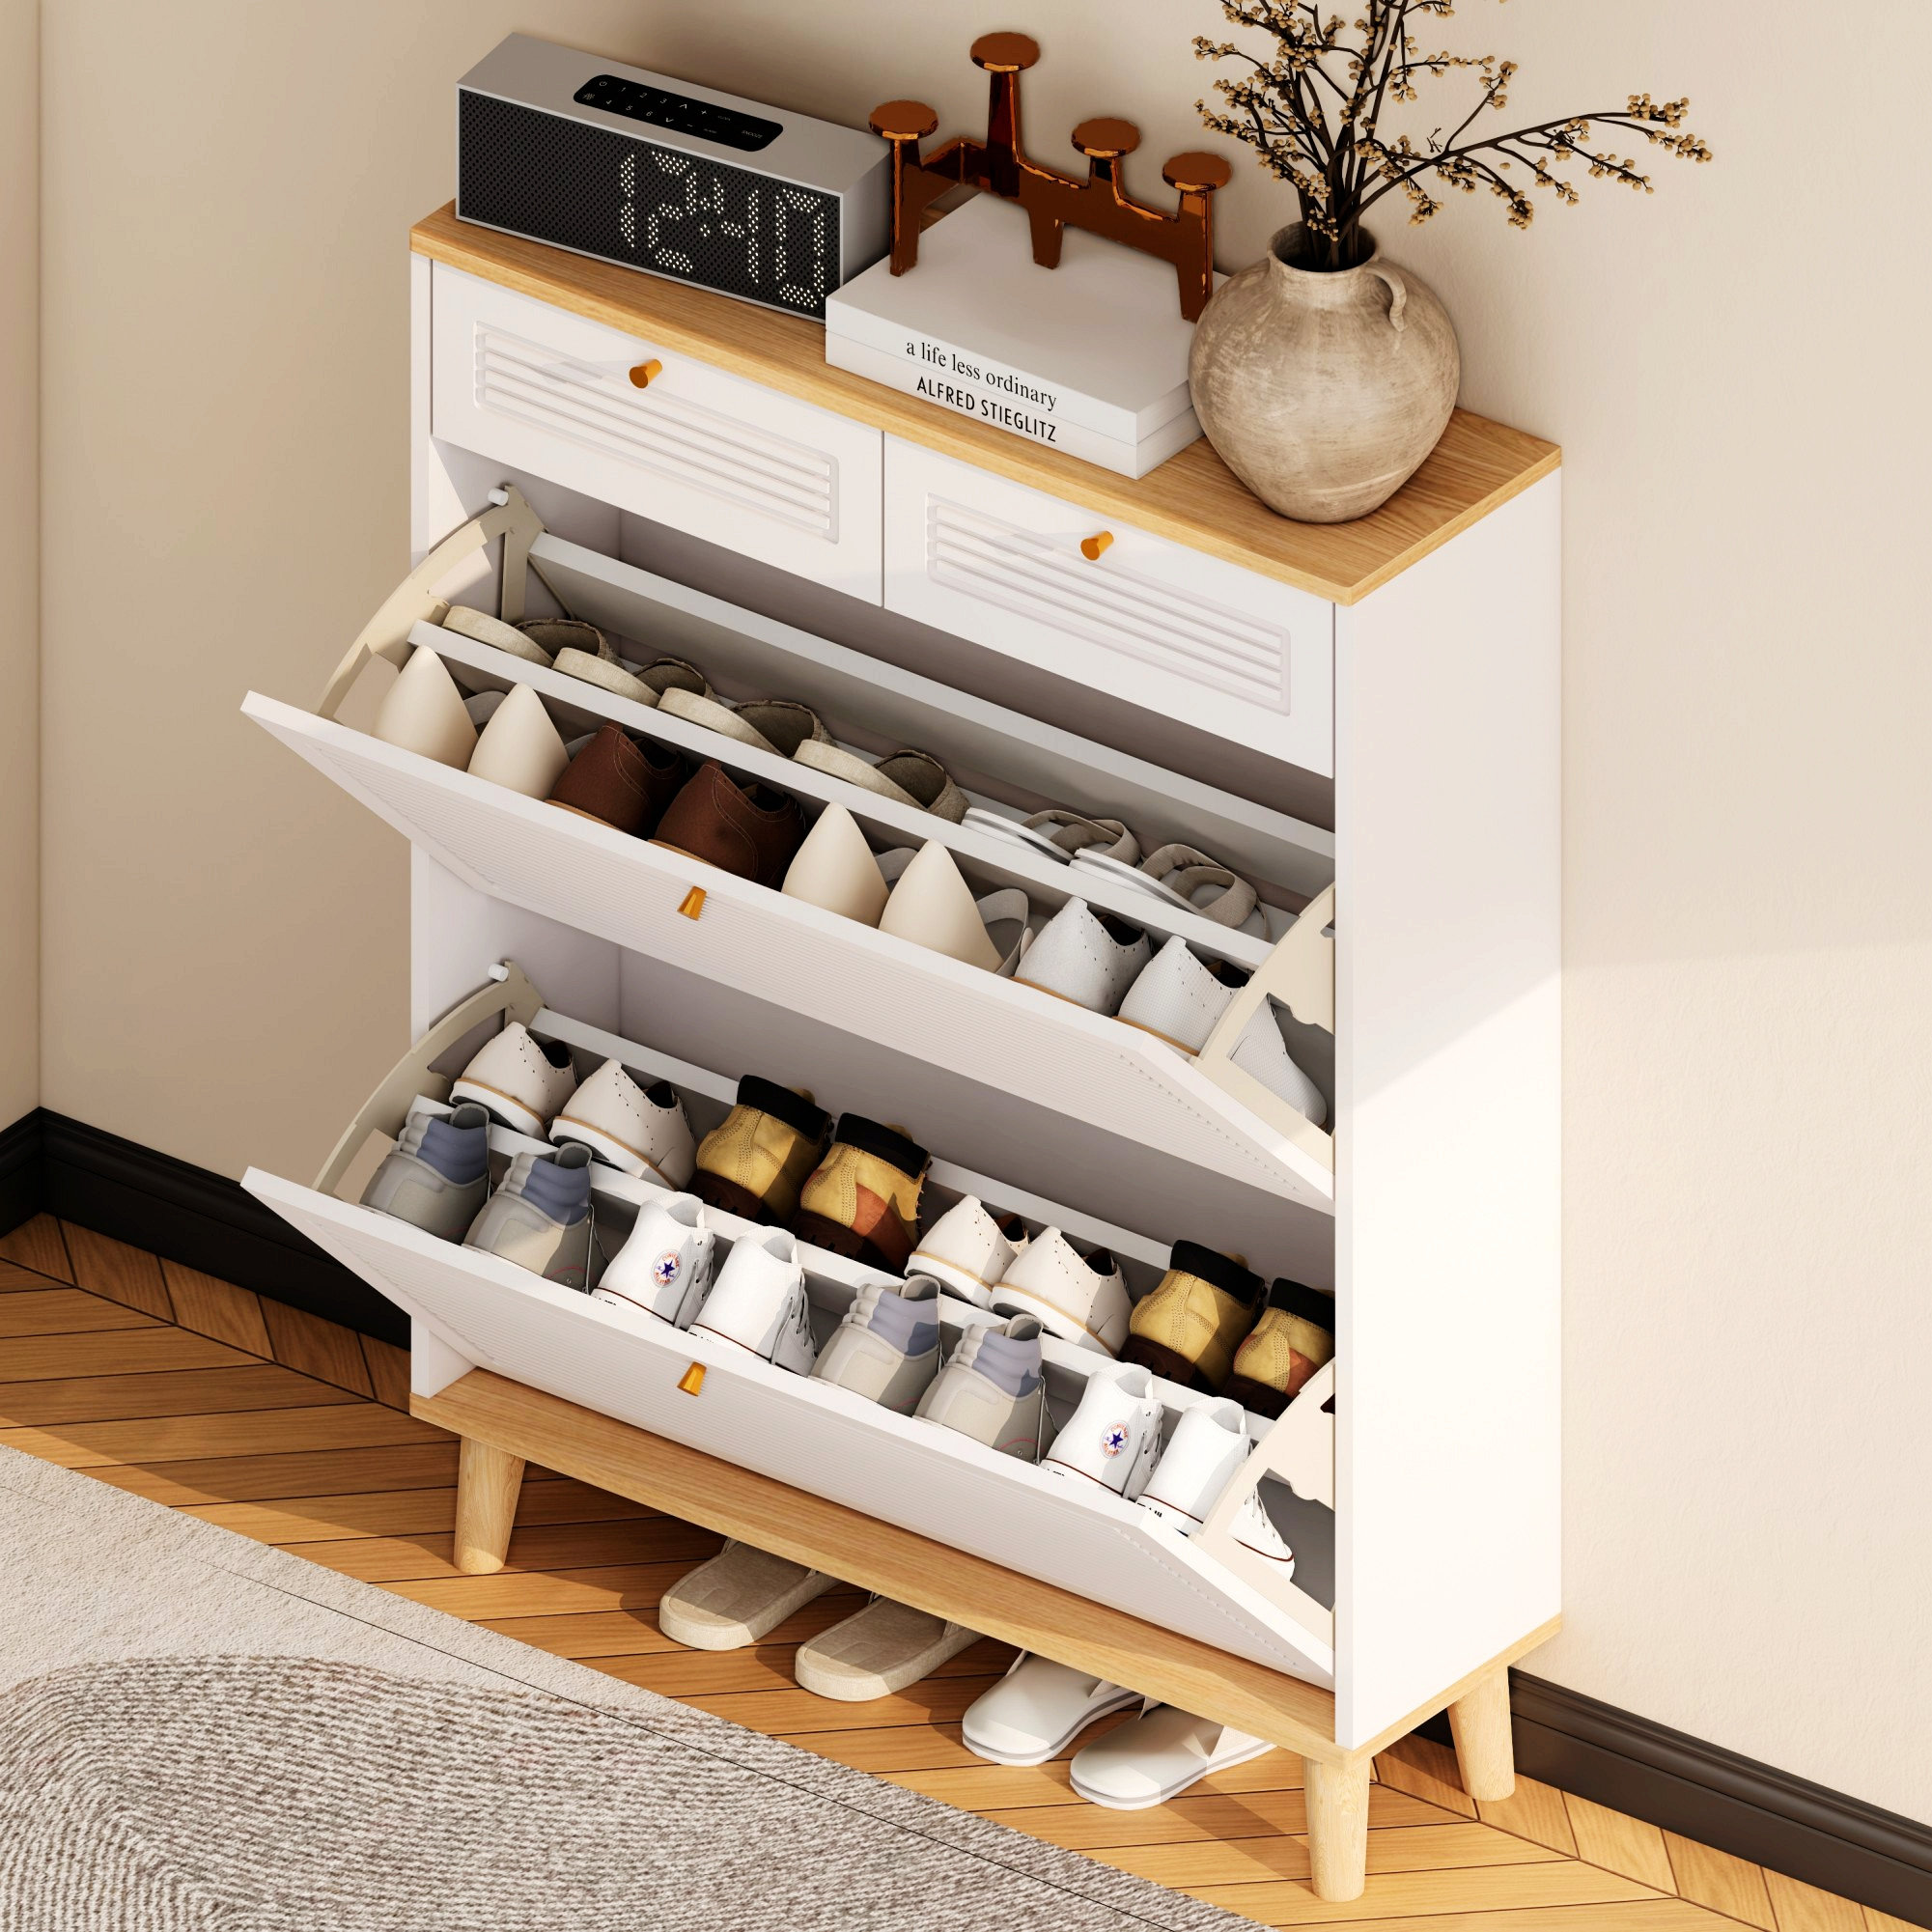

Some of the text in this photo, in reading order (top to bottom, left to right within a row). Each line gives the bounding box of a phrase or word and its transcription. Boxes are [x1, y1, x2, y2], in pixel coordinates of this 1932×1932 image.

[621, 152, 824, 308] 12:40
[907, 342, 1057, 411] a life less ordinary
[916, 377, 1056, 442] ALFRED STIEGLITZ
